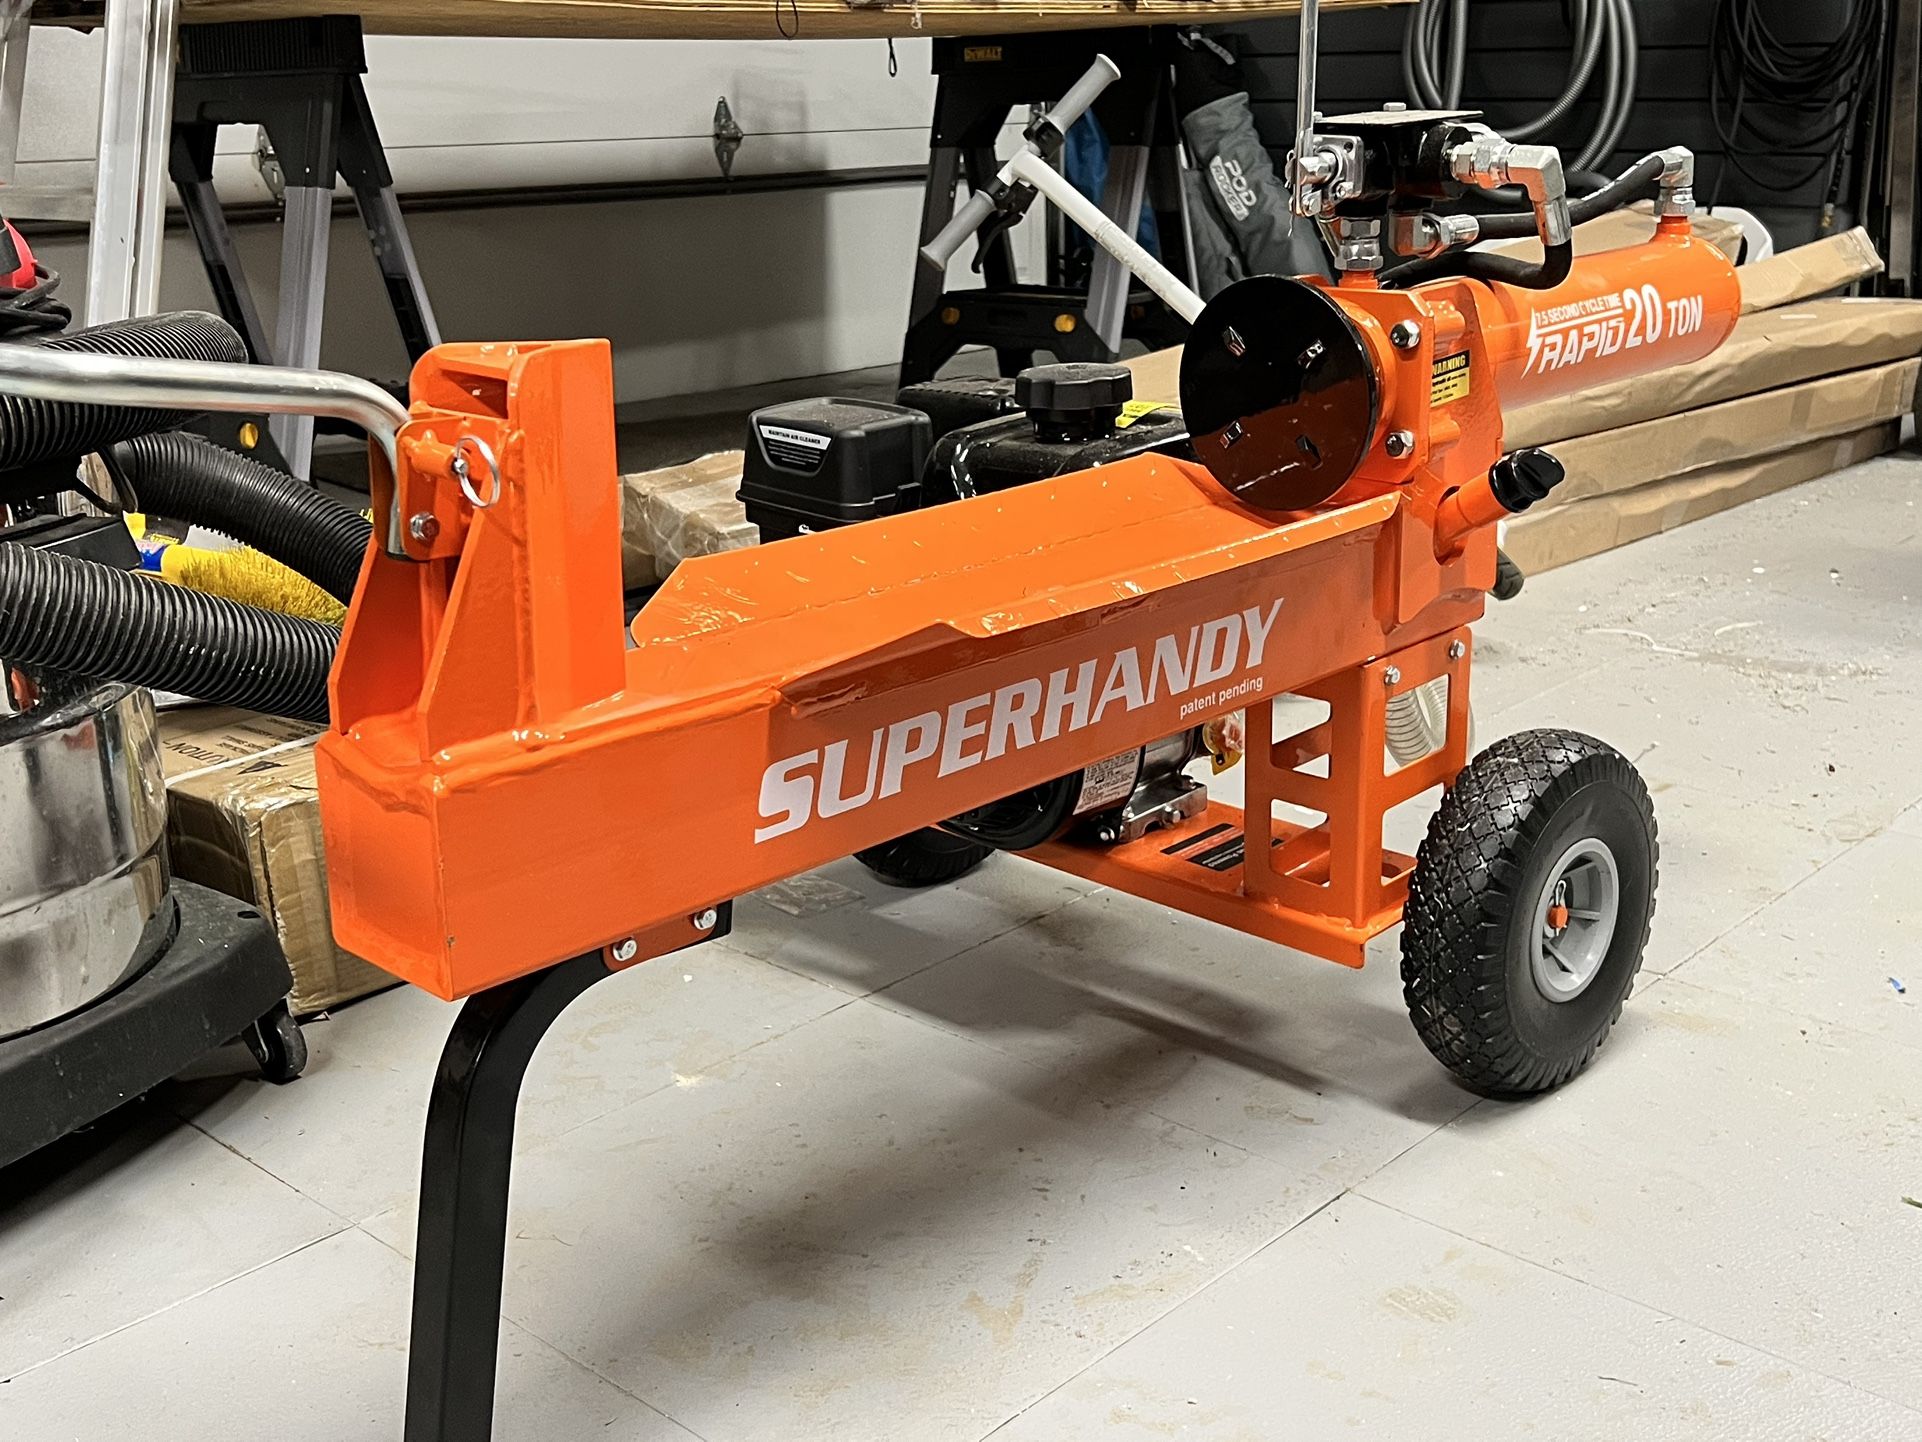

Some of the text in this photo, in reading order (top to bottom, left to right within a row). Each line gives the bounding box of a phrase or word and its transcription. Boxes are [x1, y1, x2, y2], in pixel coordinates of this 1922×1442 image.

[1224, 159, 1257, 207] POD
[1537, 283, 1703, 374] RAPID 20 TON
[1548, 302, 1580, 323] SECOND
[1579, 296, 1606, 315] CYCLE
[1603, 292, 1622, 309] TIME
[754, 597, 1285, 845] SUPERHANDY
[1179, 676, 1264, 720] patent pending
